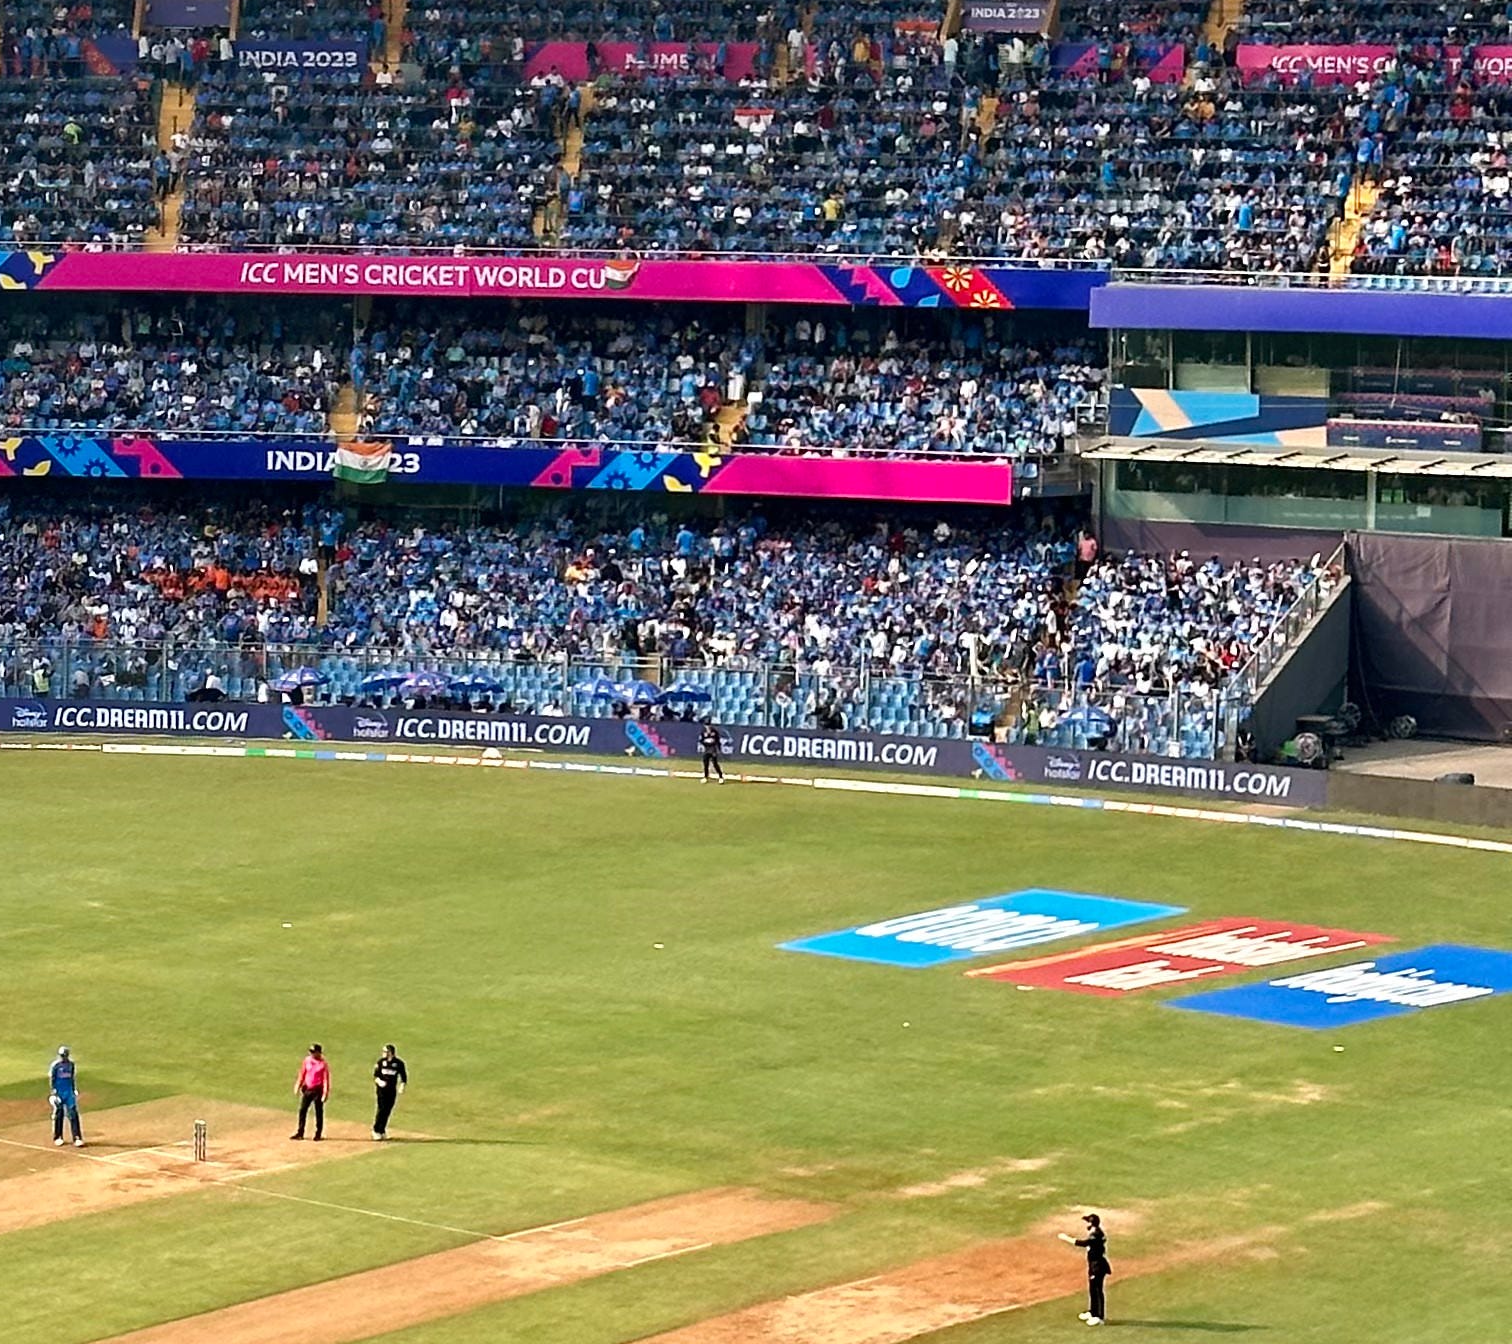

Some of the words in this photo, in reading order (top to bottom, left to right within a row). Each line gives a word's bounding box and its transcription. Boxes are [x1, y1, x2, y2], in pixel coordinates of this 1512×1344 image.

[971, 7, 1006, 19] INDIA
[238, 50, 299, 68] INDIA
[302, 51, 358, 68] 2023
[240, 261, 280, 284] ICC
[282, 263, 360, 286] MEN'S
[363, 264, 471, 288] CRICKET
[473, 265, 567, 289] WORLD
[570, 267, 613, 291] CU
[266, 450, 339, 472] INDIA
[54, 706, 248, 733] ICC.DREAM11.COM
[395, 716, 590, 746] ICC.DREAM11.COM
[740, 733, 937, 768] ICC.DREAM11.COM
[1088, 759, 1292, 798] ICC.DREAM11.COM
